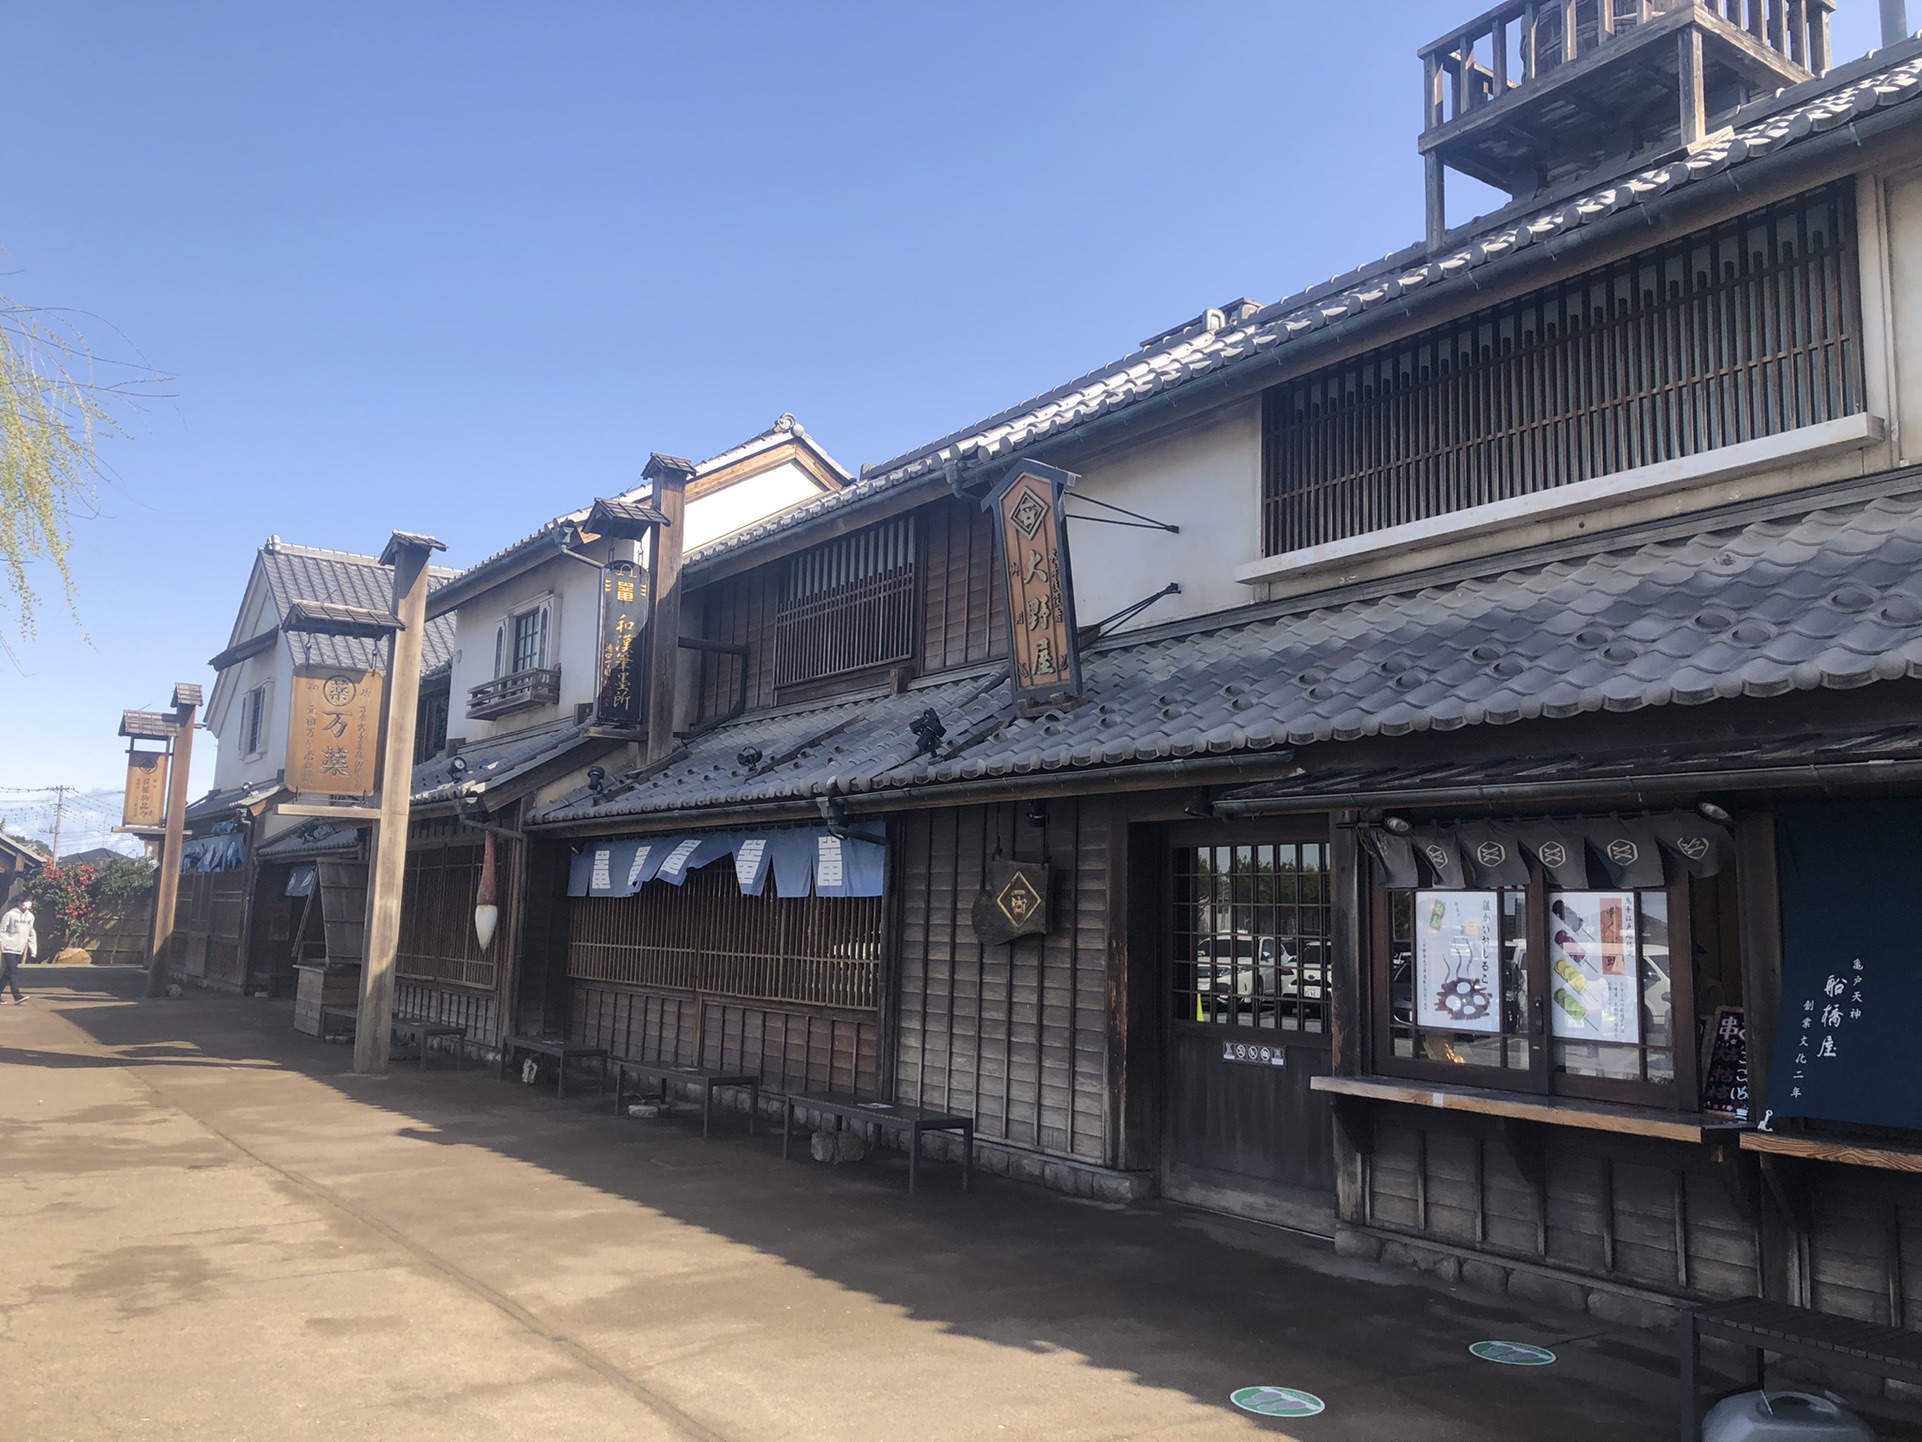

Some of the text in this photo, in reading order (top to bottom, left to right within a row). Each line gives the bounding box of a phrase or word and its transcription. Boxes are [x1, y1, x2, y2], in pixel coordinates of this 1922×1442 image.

[1023, 549, 1056, 677] 大野屋
[329, 679, 350, 702] 薬
[613, 613, 635, 711] 和漢筆墨所
[319, 710, 352, 777] 万薬
[1481, 900, 1492, 984] 温かいおしるこ
[1817, 974, 1848, 1058] 船橋屋
[1850, 958, 1864, 1020] 亀戸天神
[1790, 1000, 1815, 1099] 創業文化二年
